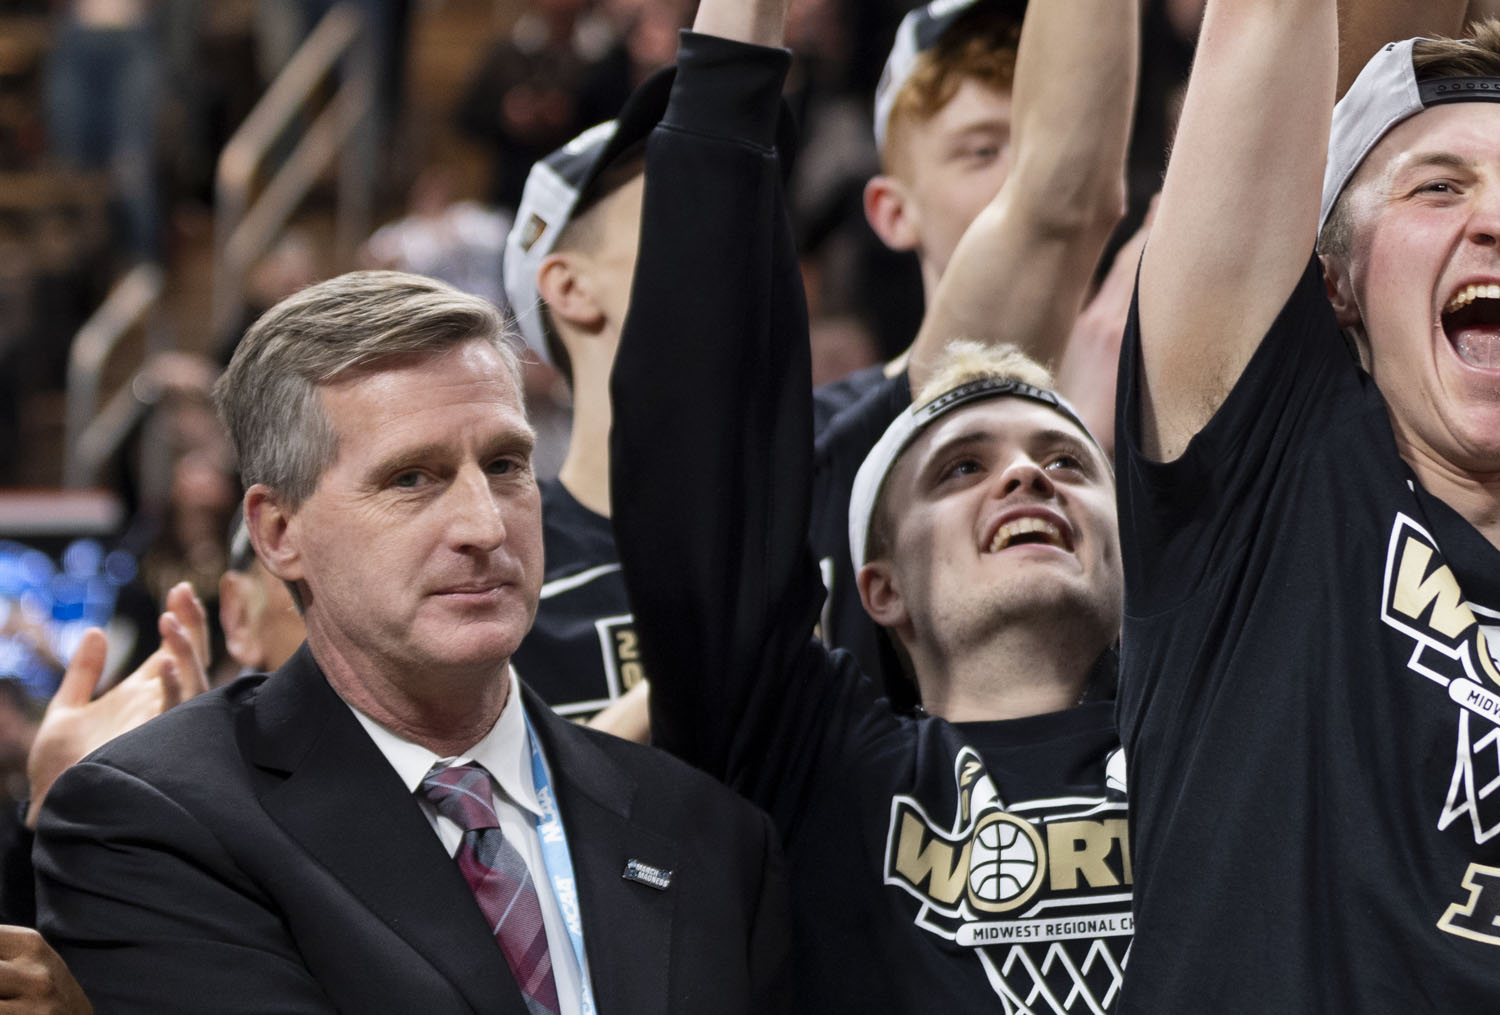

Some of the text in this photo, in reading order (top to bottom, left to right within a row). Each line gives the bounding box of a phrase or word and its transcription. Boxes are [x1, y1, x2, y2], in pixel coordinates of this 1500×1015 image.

[636, 864, 660, 877] MARCH
[637, 871, 671, 888] MADNESS
[973, 924, 1041, 941] MIDWEST
[1045, 919, 1116, 936] REGIONAL
